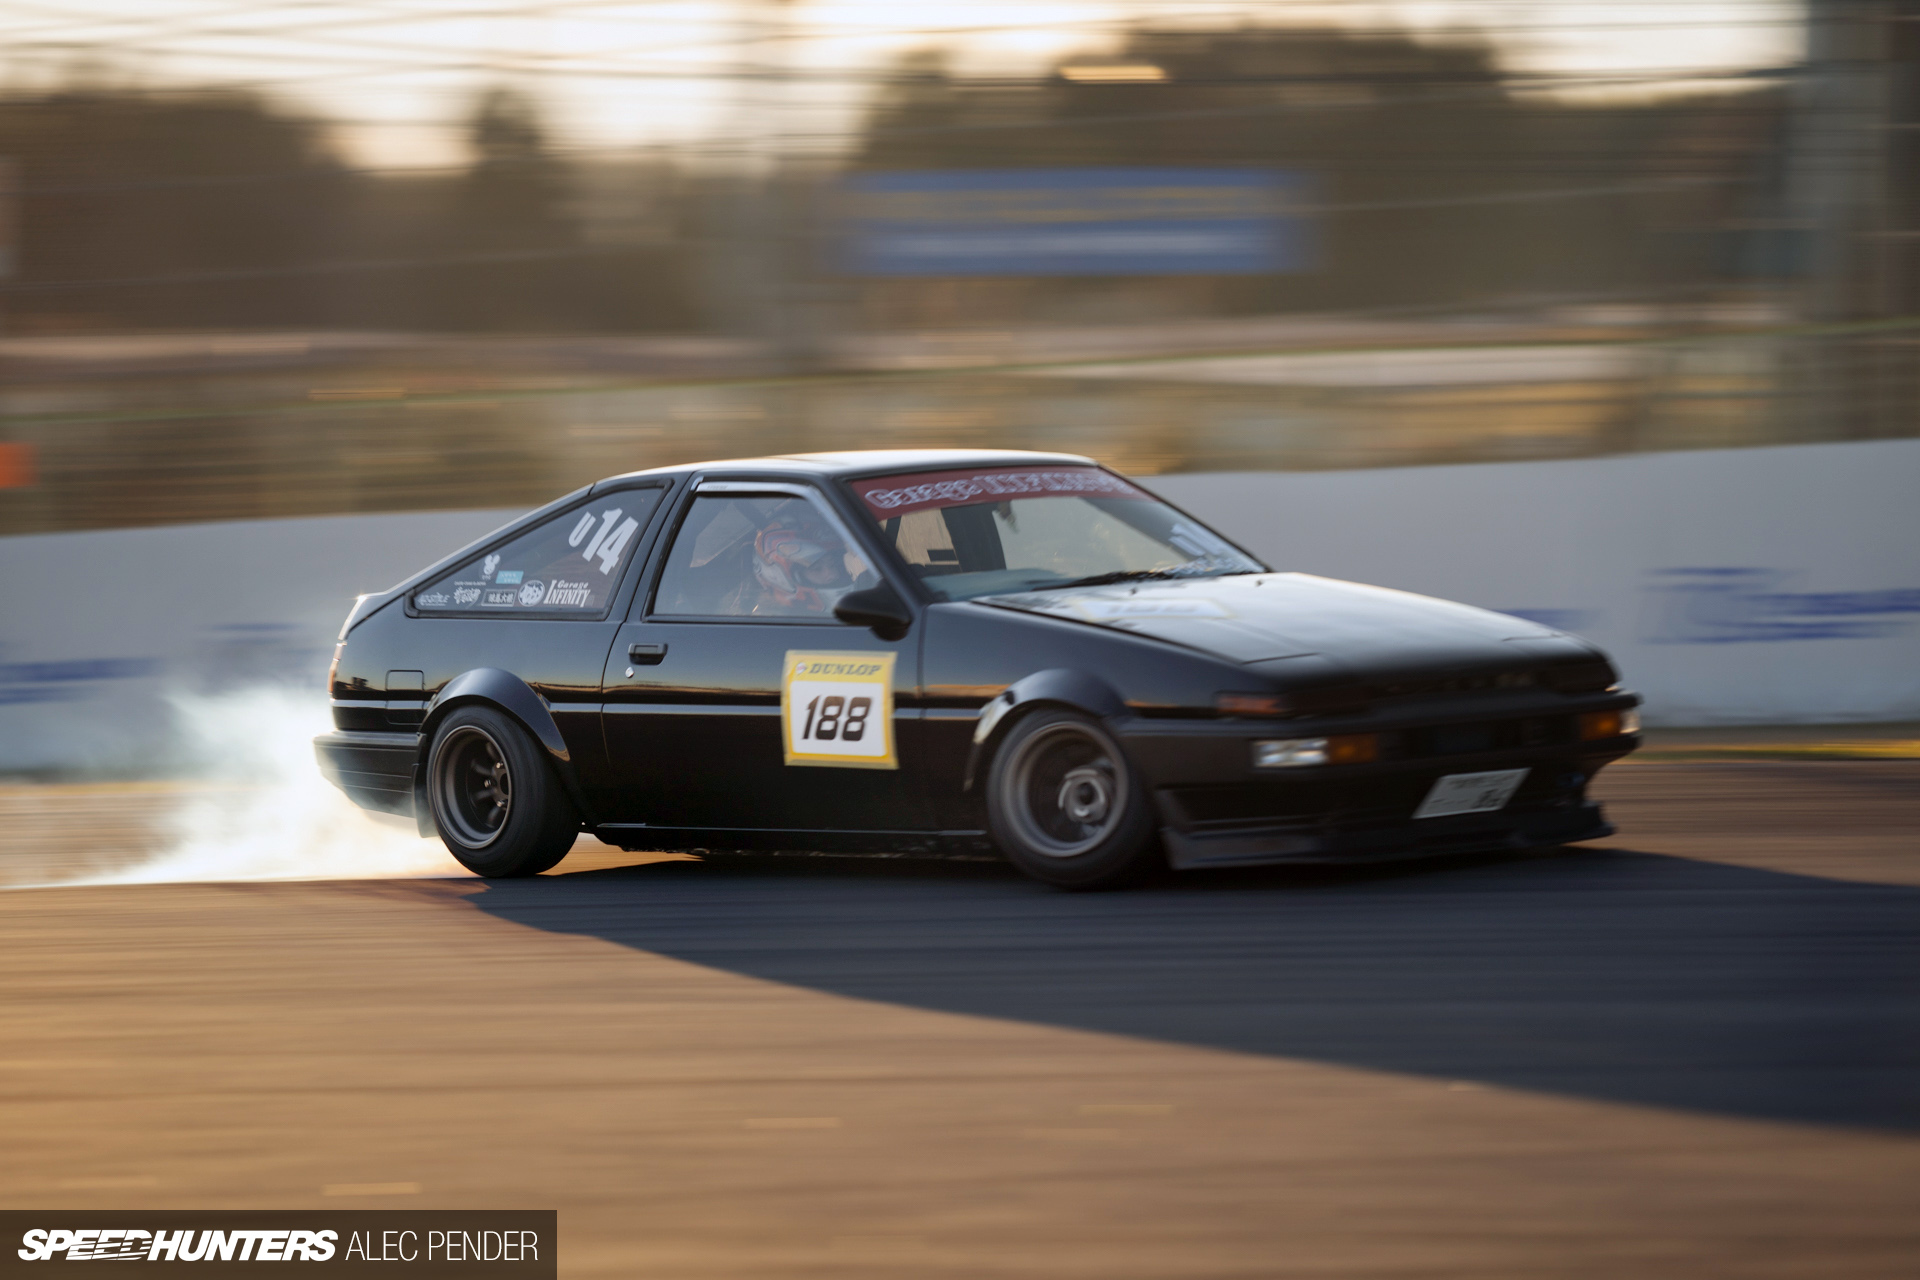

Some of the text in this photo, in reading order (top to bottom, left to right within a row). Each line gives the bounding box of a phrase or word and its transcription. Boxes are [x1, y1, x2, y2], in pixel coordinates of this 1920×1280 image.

[543, 580, 591, 608] INFINITY
[557, 580, 589, 590] Garage
[808, 663, 882, 676] DUNLOP
[802, 694, 873, 742] 188
